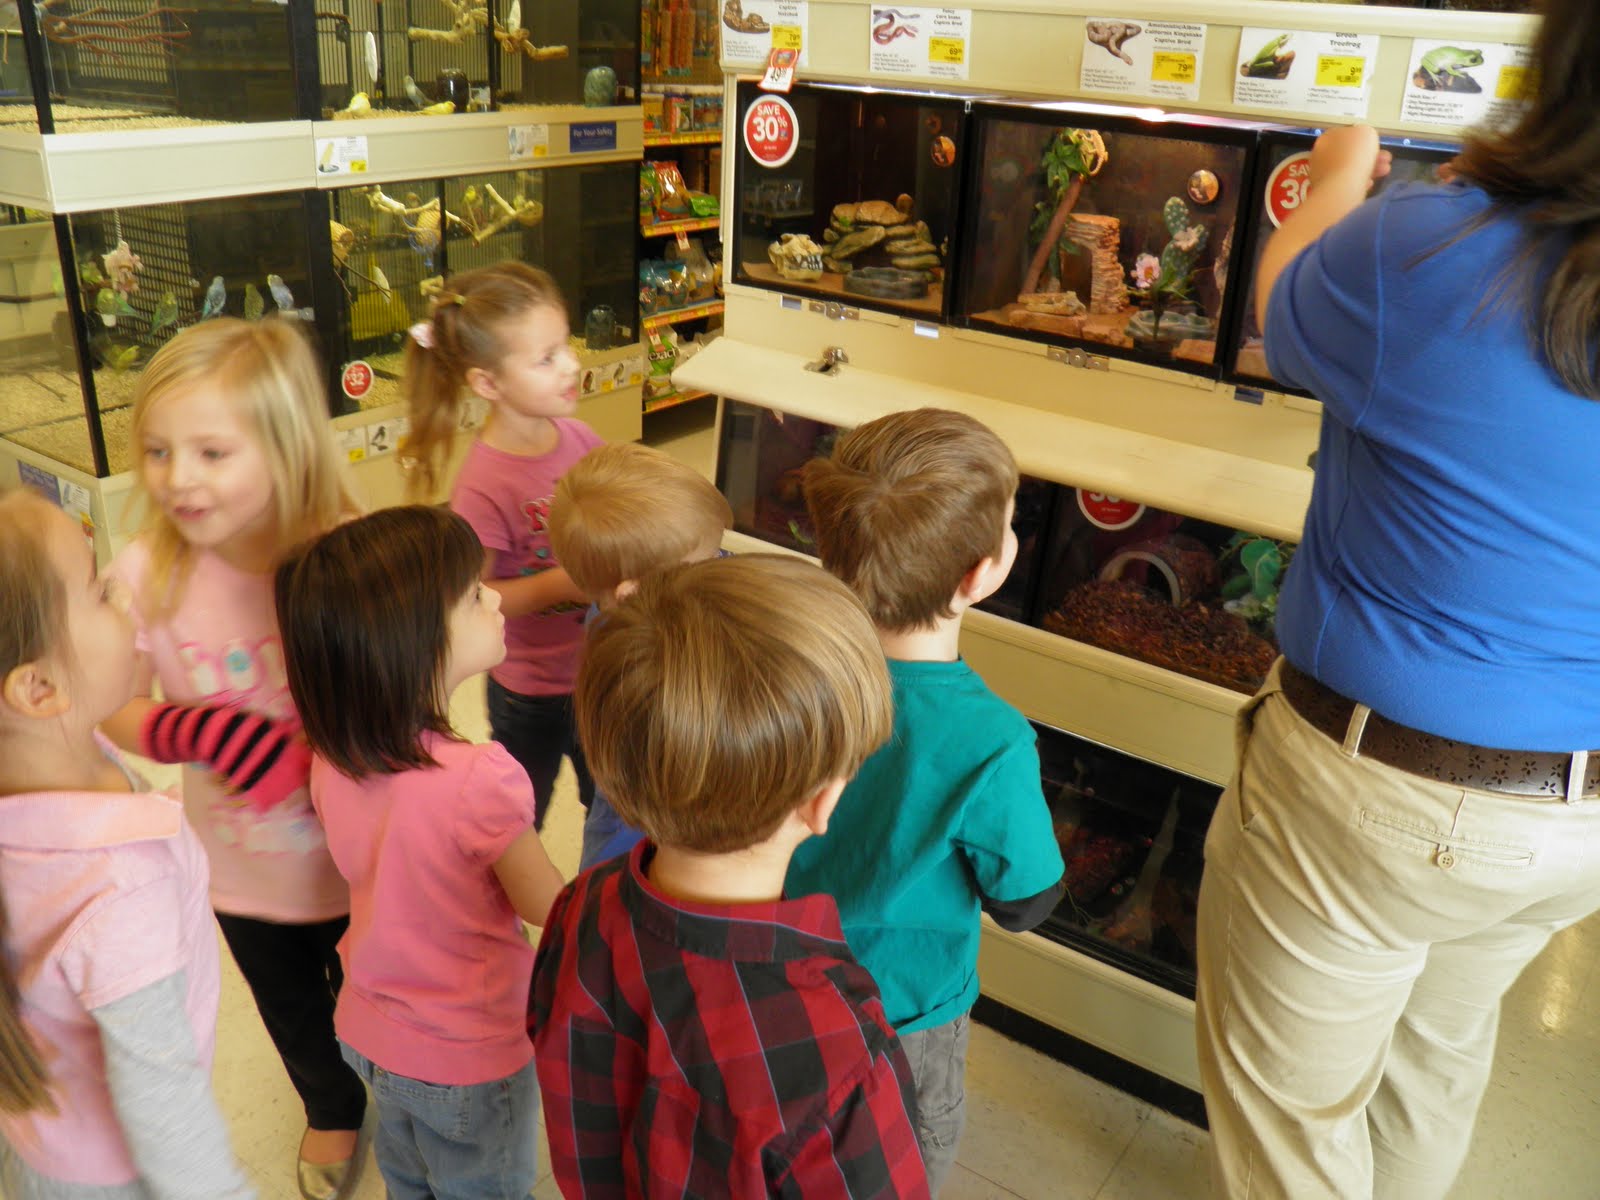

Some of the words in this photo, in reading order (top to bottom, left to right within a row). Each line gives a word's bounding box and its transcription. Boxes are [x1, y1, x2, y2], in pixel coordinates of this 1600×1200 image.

[1335, 31, 1358, 39] Green
[1329, 39, 1361, 49] Treefrog
[757, 104, 781, 116] SAVE
[1288, 164, 1311, 177] SA
